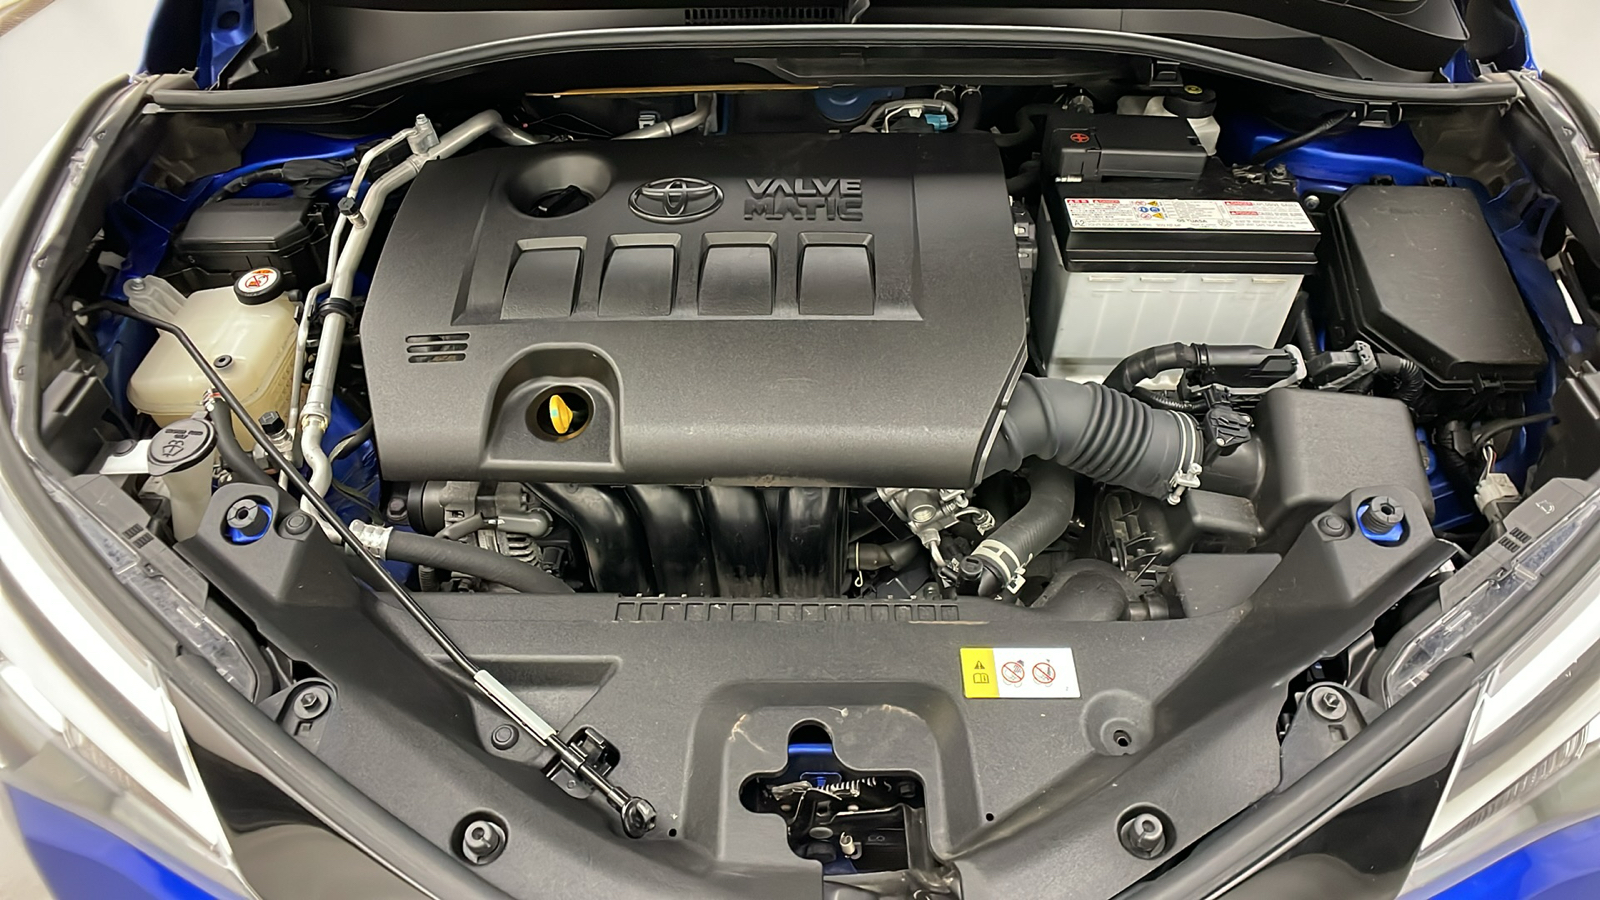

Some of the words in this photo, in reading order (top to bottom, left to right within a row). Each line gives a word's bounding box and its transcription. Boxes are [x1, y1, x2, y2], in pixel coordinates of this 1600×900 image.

[745, 178, 862, 197] VALVE
[743, 197, 863, 221] MATIC
[1074, 219, 1085, 227] A2
